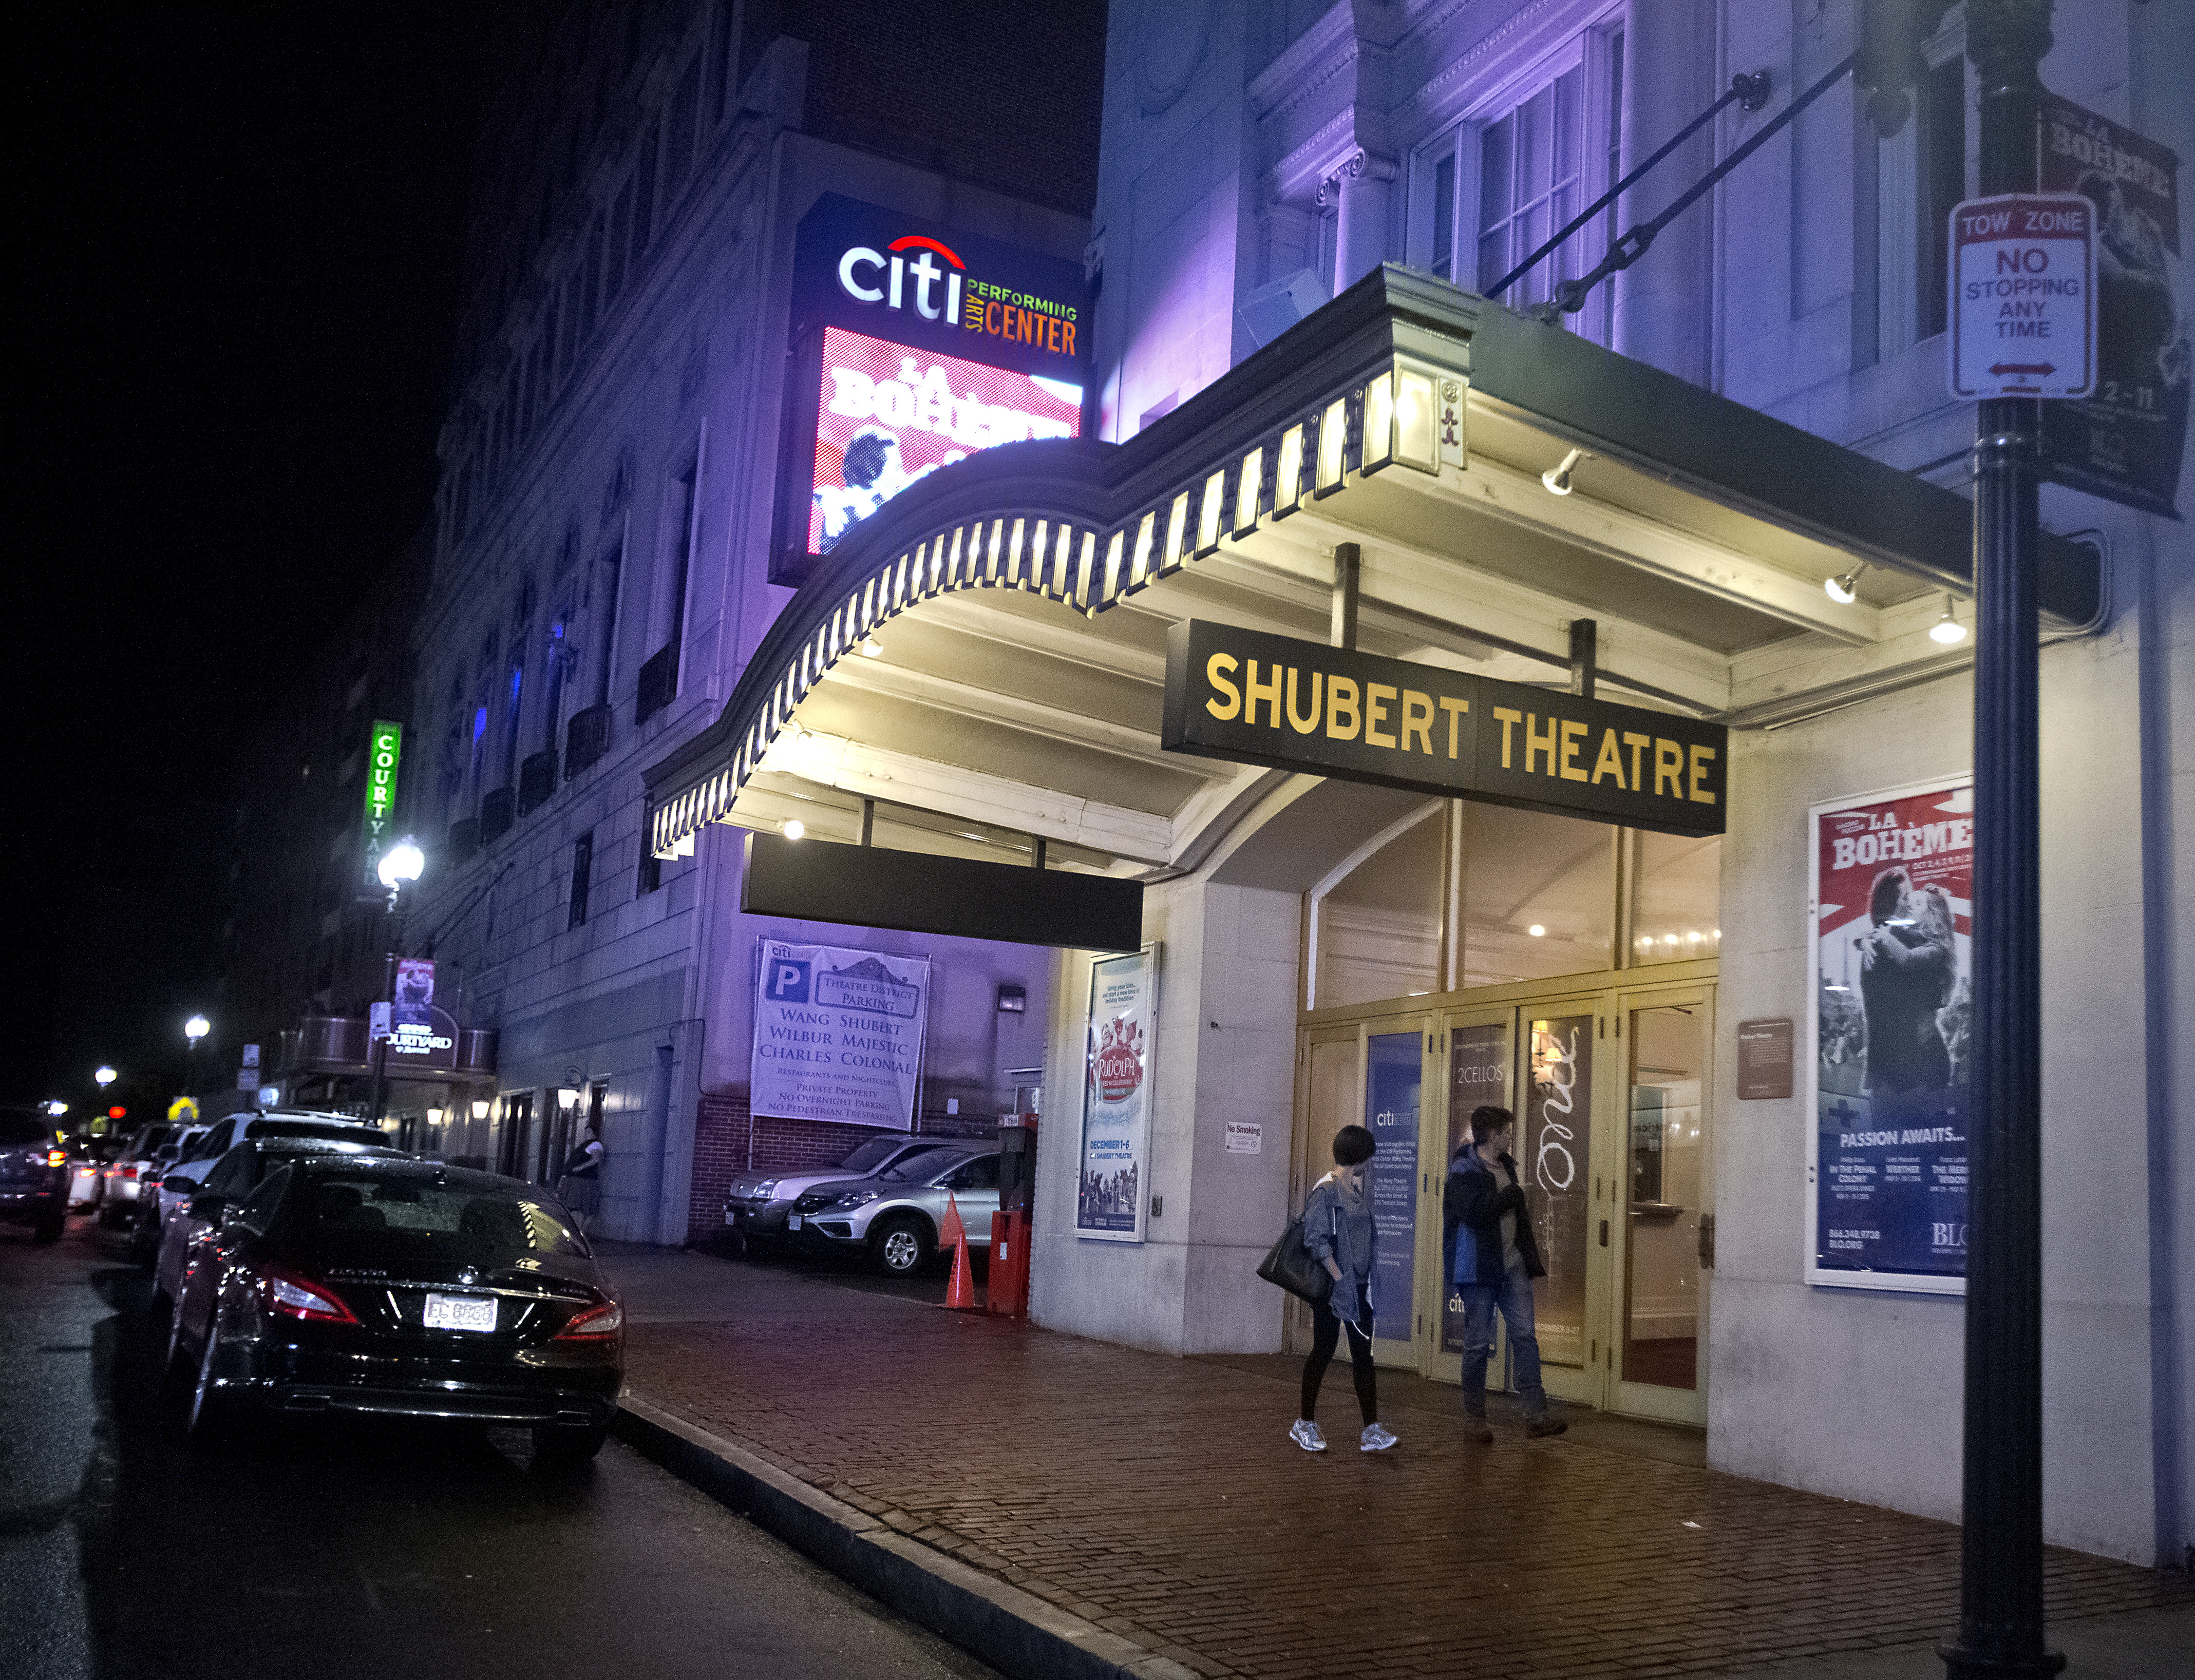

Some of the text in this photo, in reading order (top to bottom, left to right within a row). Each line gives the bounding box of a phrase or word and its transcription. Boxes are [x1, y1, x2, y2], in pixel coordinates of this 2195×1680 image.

[2085, 118, 2111, 144] LA
[1962, 211, 2084, 237] TOW ZONE
[1997, 247, 2049, 275] NO
[839, 243, 962, 326] citi
[1966, 278, 2079, 301] STOPPING
[968, 279, 1077, 321] PERFORMING
[1998, 300, 2047, 318] ANY
[965, 293, 985, 333] ARTS
[985, 301, 1077, 356] CENTER
[1994, 320, 2052, 339] TIME
[1205, 652, 1717, 805] SHUBERT THEATRE
[1868, 812, 1898, 831] LA
[1832, 818, 1973, 870] BOHÈME
[772, 946, 791, 958] citi
[775, 964, 801, 996] P
[825, 978, 914, 1000] THEATRE DISTRICT
[842, 993, 895, 1011] PARKING
[781, 1007, 904, 1036] WANG SHUBERT
[386, 1033, 452, 1049] OURTYARD
[770, 1026, 909, 1056] WILBUR MAJESTIC
[760, 1044, 913, 1075] CHARLES COLONIAL
[1099, 1058, 1135, 1078] RUDOLPH
[778, 1067, 830, 1079] RESTAURANTS
[1459, 1065, 1503, 1083] 2CELLOS
[797, 1083, 878, 1098] PRIVATE PROPERTY
[779, 1093, 891, 1111] NO OVERNIGHT PARKING
[769, 1103, 898, 1122] NO PEDESTRIAN TRESPASSING
[1377, 1110, 1394, 1126] citi
[1227, 1124, 1260, 1136] No Smoking
[1840, 1131, 1898, 1148] PASSION
[1090, 1140, 1129, 1149] DECEMBER 1-6
[1829, 1240, 1863, 1249] BLO.ORG
